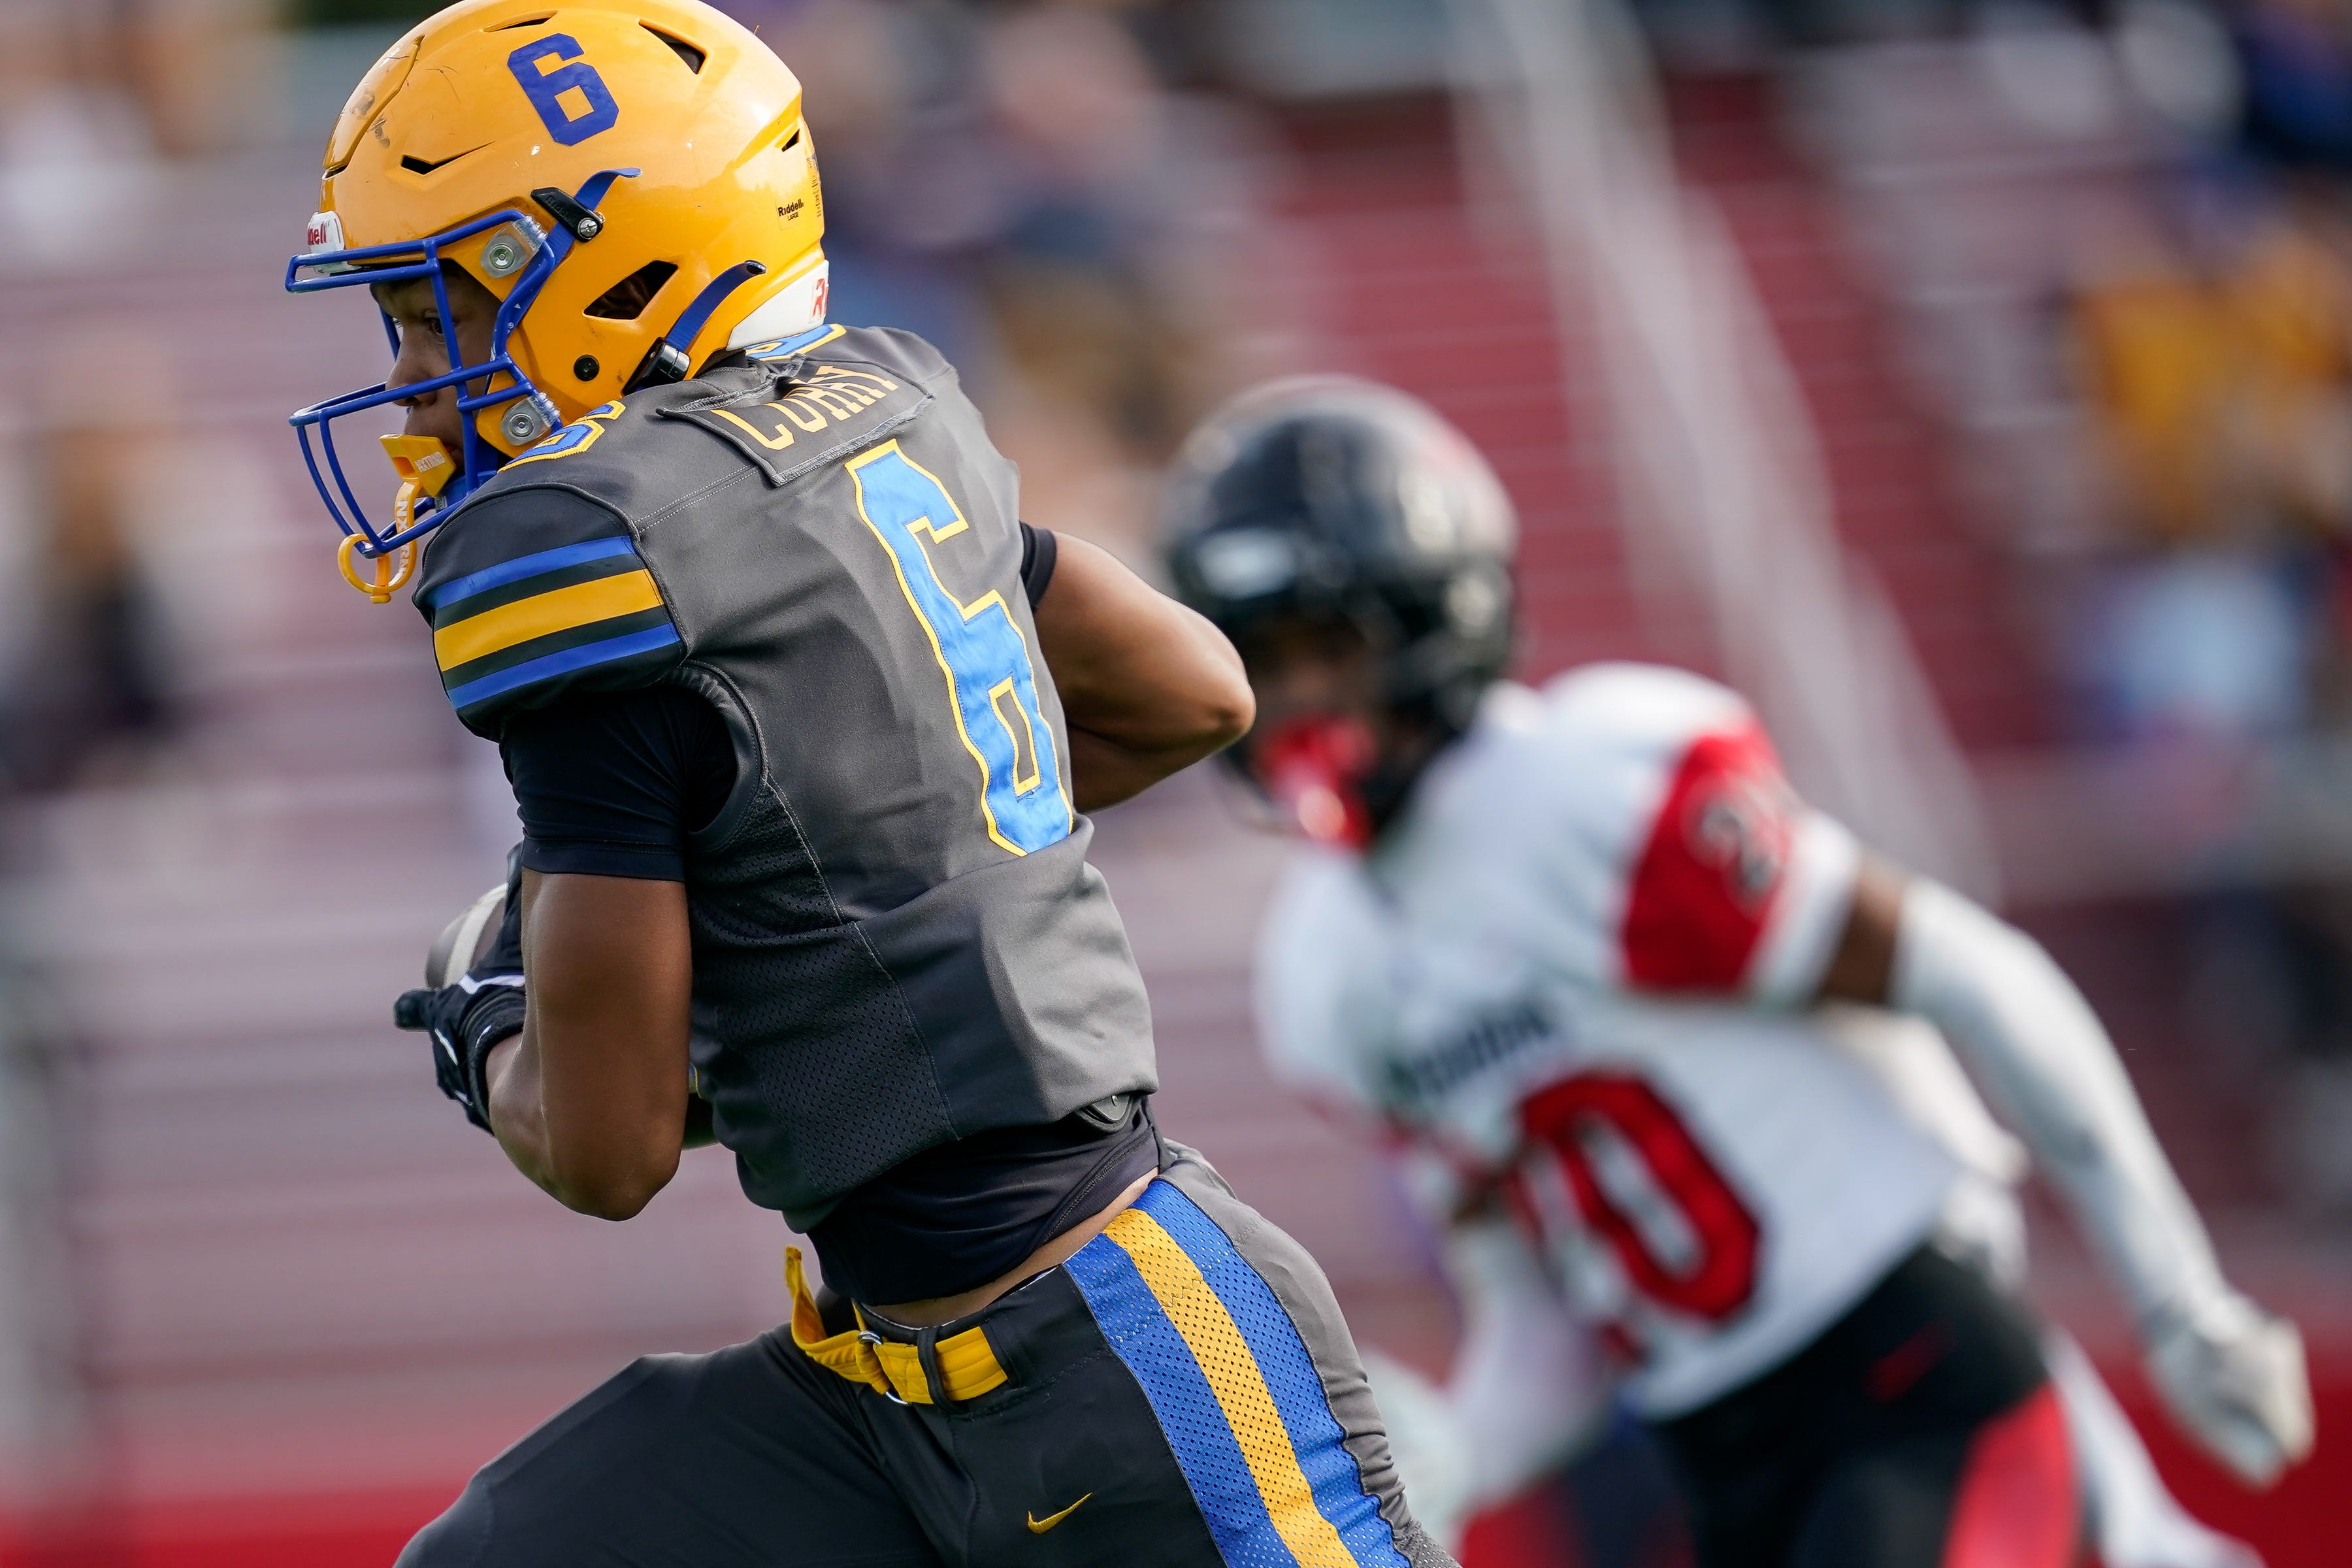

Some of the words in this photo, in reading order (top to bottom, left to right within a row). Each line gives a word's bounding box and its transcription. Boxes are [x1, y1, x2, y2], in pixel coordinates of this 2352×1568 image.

[508, 33, 619, 146] 6
[777, 199, 804, 217] Riddell
[844, 438, 1075, 857] 6
[1503, 1070, 1761, 1365] 0
